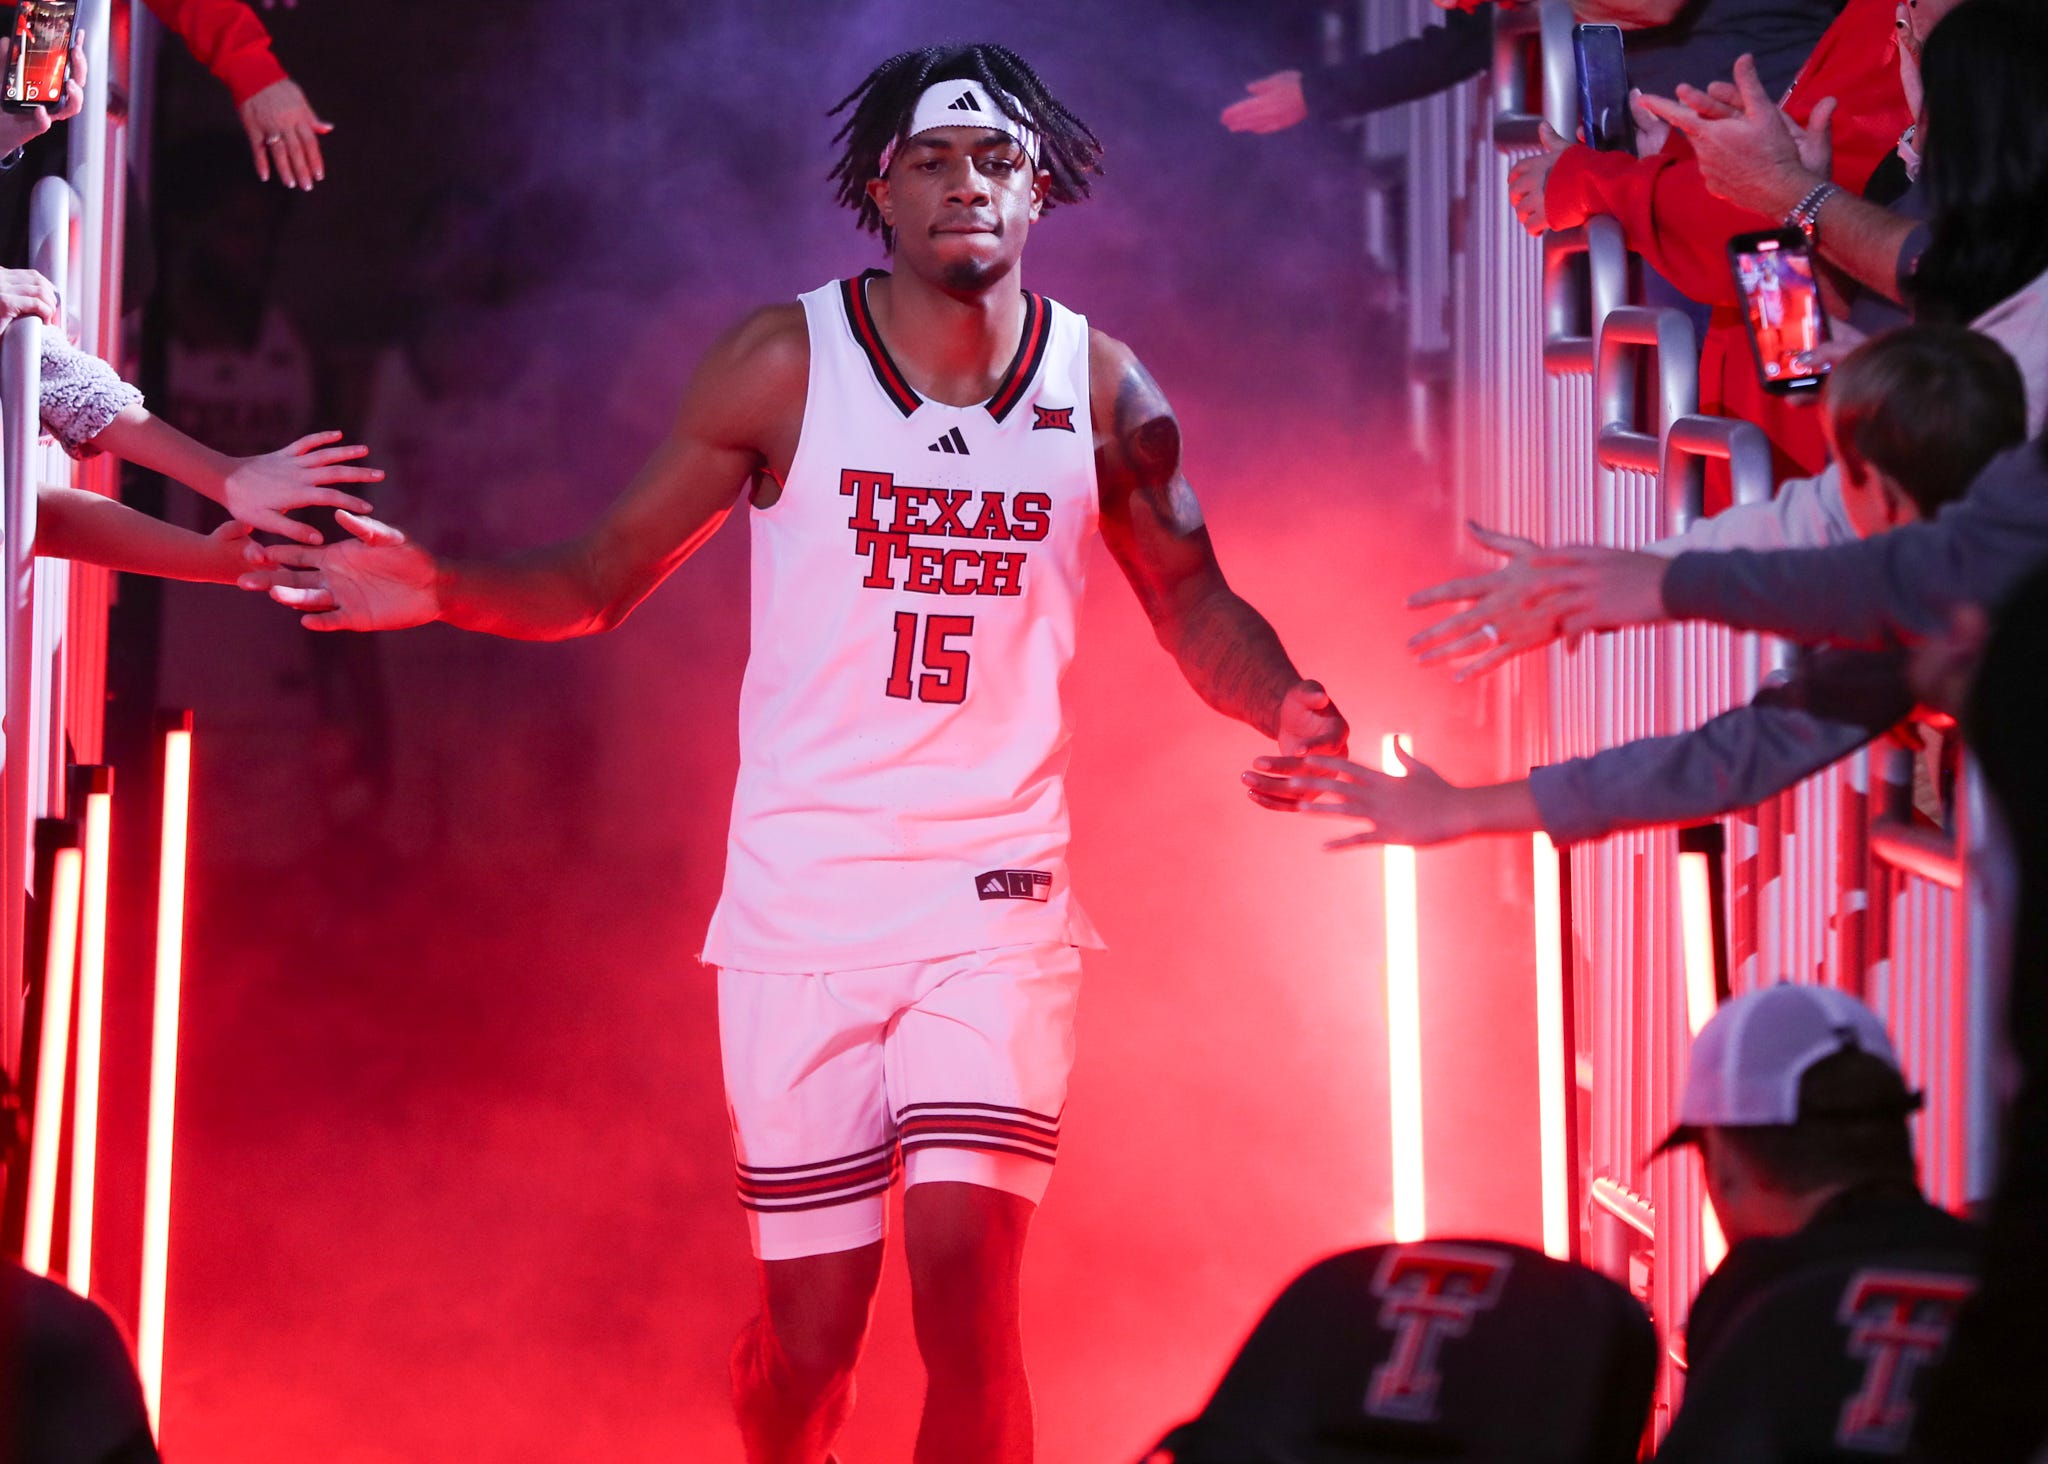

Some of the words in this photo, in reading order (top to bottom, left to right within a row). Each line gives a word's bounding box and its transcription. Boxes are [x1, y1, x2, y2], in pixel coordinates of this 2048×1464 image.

[840, 468, 1052, 541] TEXAS
[855, 529, 1027, 596] TECH
[886, 611, 974, 705] 15
